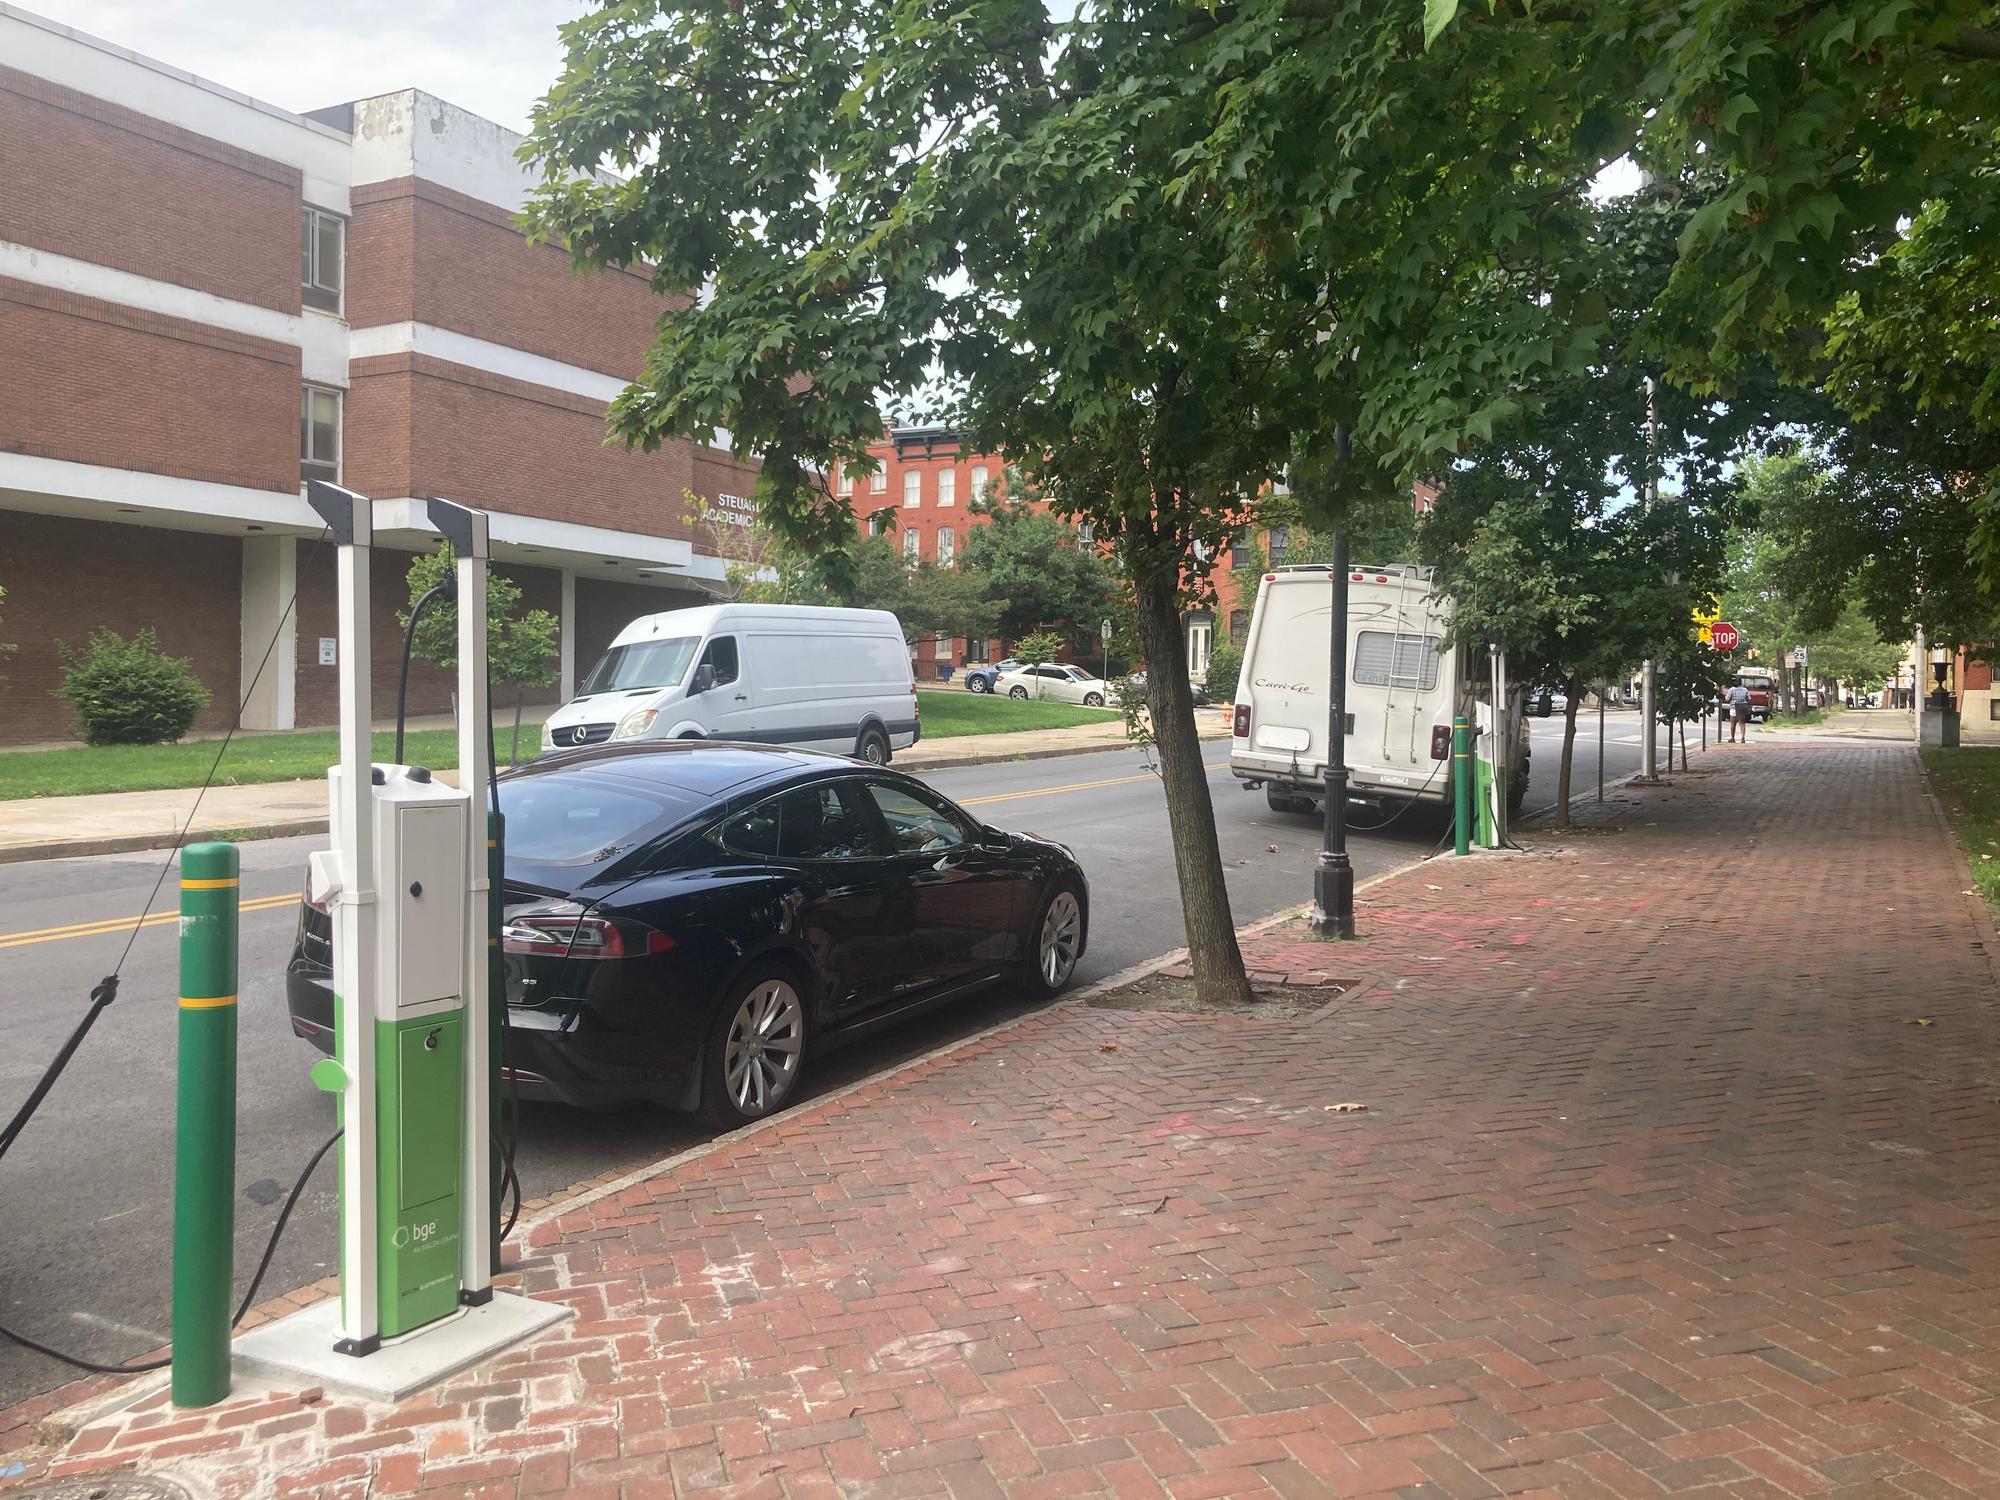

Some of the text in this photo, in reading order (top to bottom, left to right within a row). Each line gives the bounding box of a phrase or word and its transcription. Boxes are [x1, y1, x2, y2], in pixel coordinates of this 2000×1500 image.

[1711, 632, 1736, 645] TOP
[1794, 652, 1805, 660] 25
[1255, 678, 1311, 693] Carri-Go
[413, 1221, 436, 1241] bge
